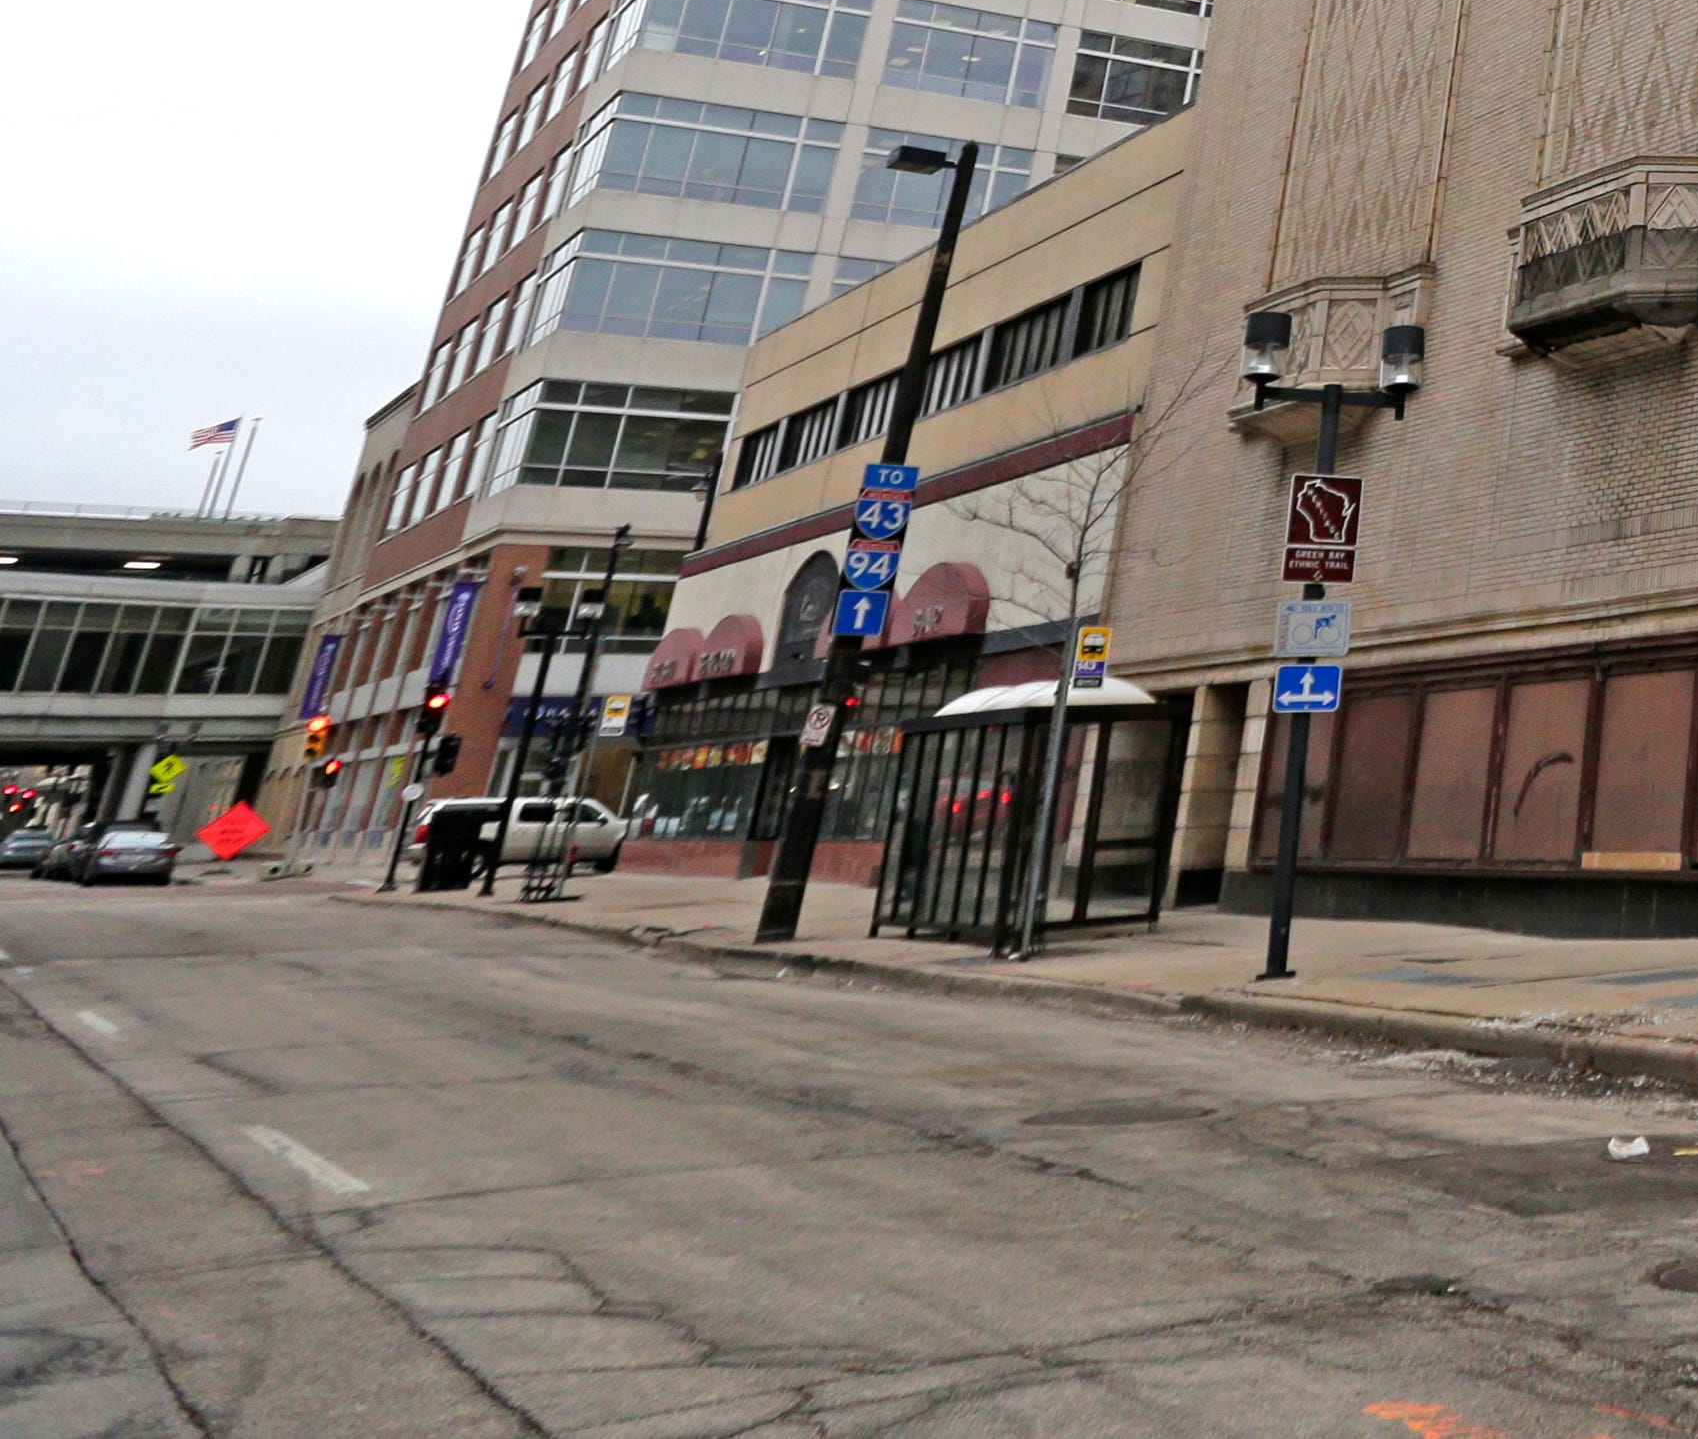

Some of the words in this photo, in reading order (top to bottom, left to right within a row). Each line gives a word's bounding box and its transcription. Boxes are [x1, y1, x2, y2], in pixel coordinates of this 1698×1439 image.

[877, 468, 904, 485] TO
[858, 502, 905, 530] 43
[1295, 550, 1324, 559] GREEN
[1328, 551, 1346, 560] BAY
[849, 552, 891, 581] 94
[1288, 560, 1320, 569] ETHNIC
[1324, 561, 1350, 570] TRAIL
